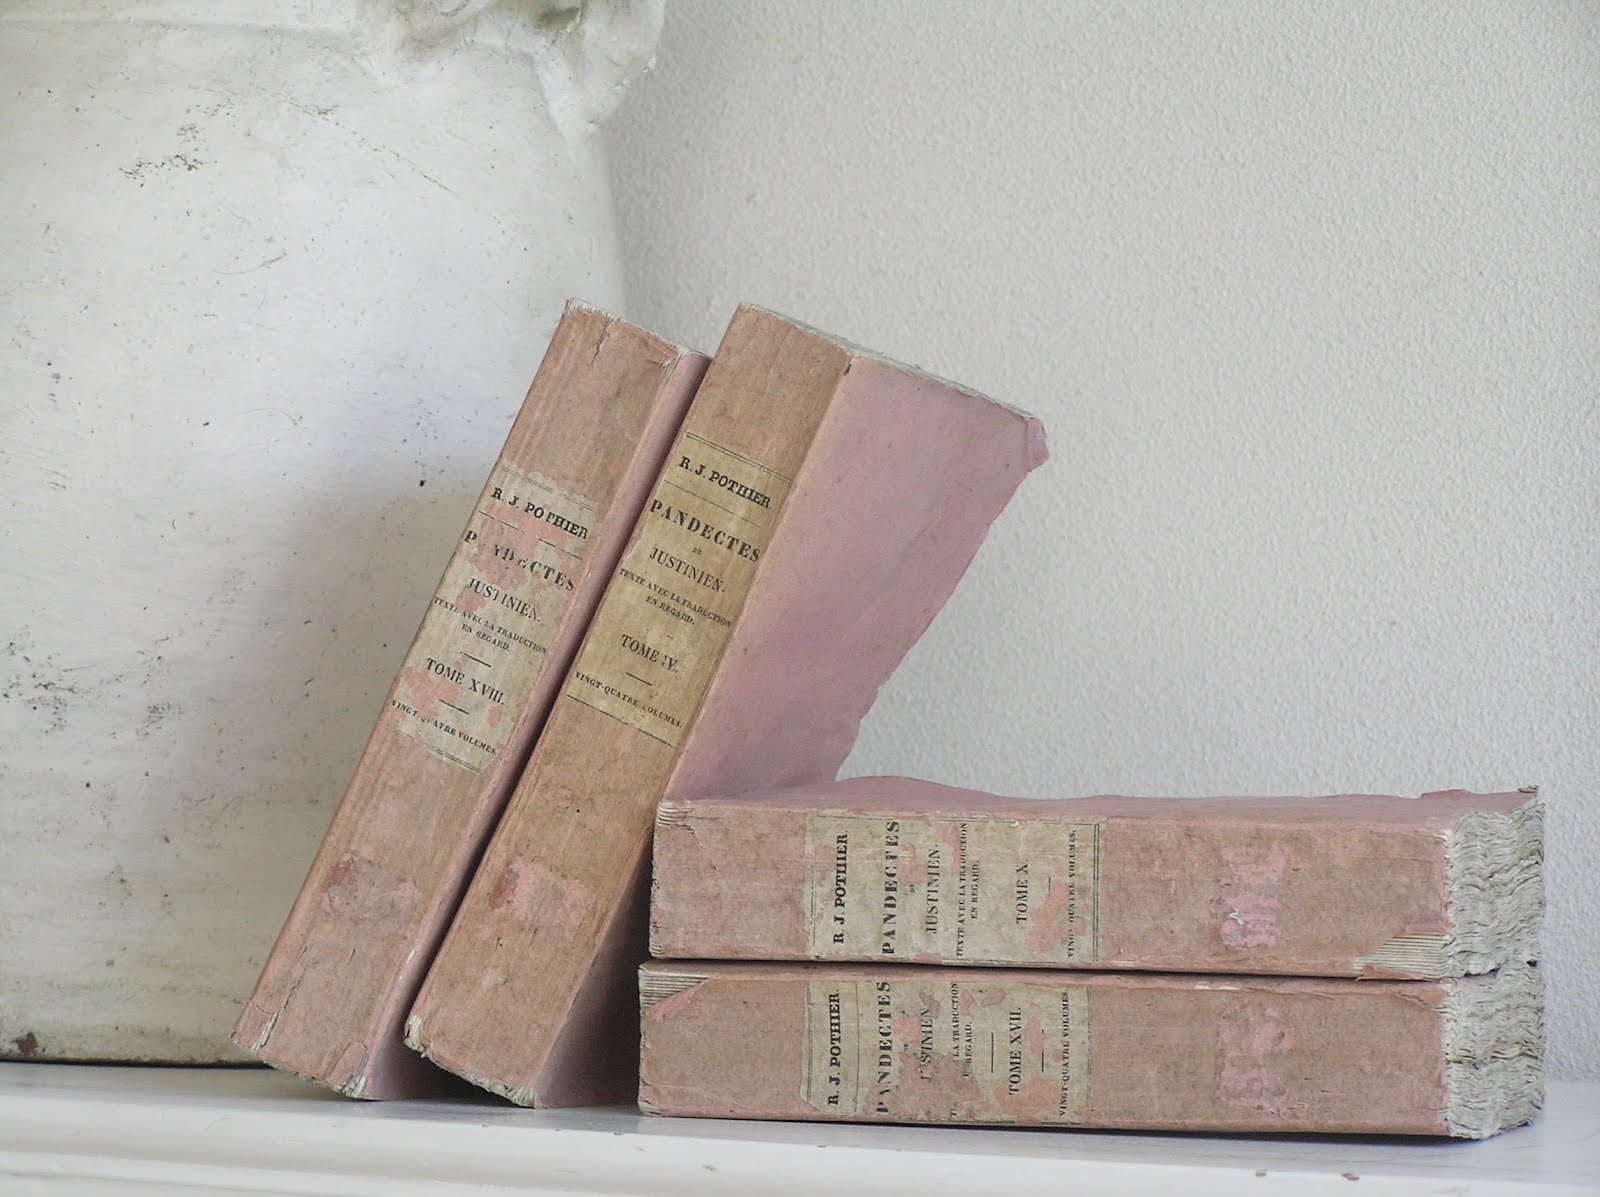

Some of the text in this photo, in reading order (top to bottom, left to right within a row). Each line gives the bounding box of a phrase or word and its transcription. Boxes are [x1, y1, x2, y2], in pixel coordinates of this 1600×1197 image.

[491, 487, 507, 501] R.
[508, 495, 522, 508] J.
[678, 456, 774, 510] R. J. POTHIER.
[650, 499, 761, 563] PANDECTES
[649, 547, 727, 595] JUSTINIEN.
[620, 568, 732, 627] TEXTE AVEC LA TRADUCTION
[646, 596, 696, 625] EN REGARD.
[461, 624, 473, 634] EN
[484, 620, 496, 631] LA
[496, 626, 547, 655] TRADUCTION
[620, 634, 660, 663] TOME
[426, 657, 506, 706] TOME XVIII.
[643, 705, 683, 728] OLUMES.
[458, 732, 498, 756] VOLUMES.
[1068, 830, 1076, 878] VOLUMES.
[833, 830, 848, 944] R. J. POTHIER.
[882, 821, 899, 954] PANDECTES
[926, 844, 940, 934] JUSTINIEN.
[959, 884, 966, 896] LA
[971, 860, 979, 919] EN REGARD.
[1016, 859, 1029, 924] TOME X.
[958, 899, 966, 925] AVEC
[956, 927, 965, 957] TEXTE
[950, 982, 960, 1057] LA TRADUCTION
[1061, 989, 1069, 1038] VOLUMES.
[827, 989, 841, 1105] R. J. POTHIER.
[965, 1022, 973, 1064] REGARD.
[1008, 1007, 1022, 1095] TOME XVII.
